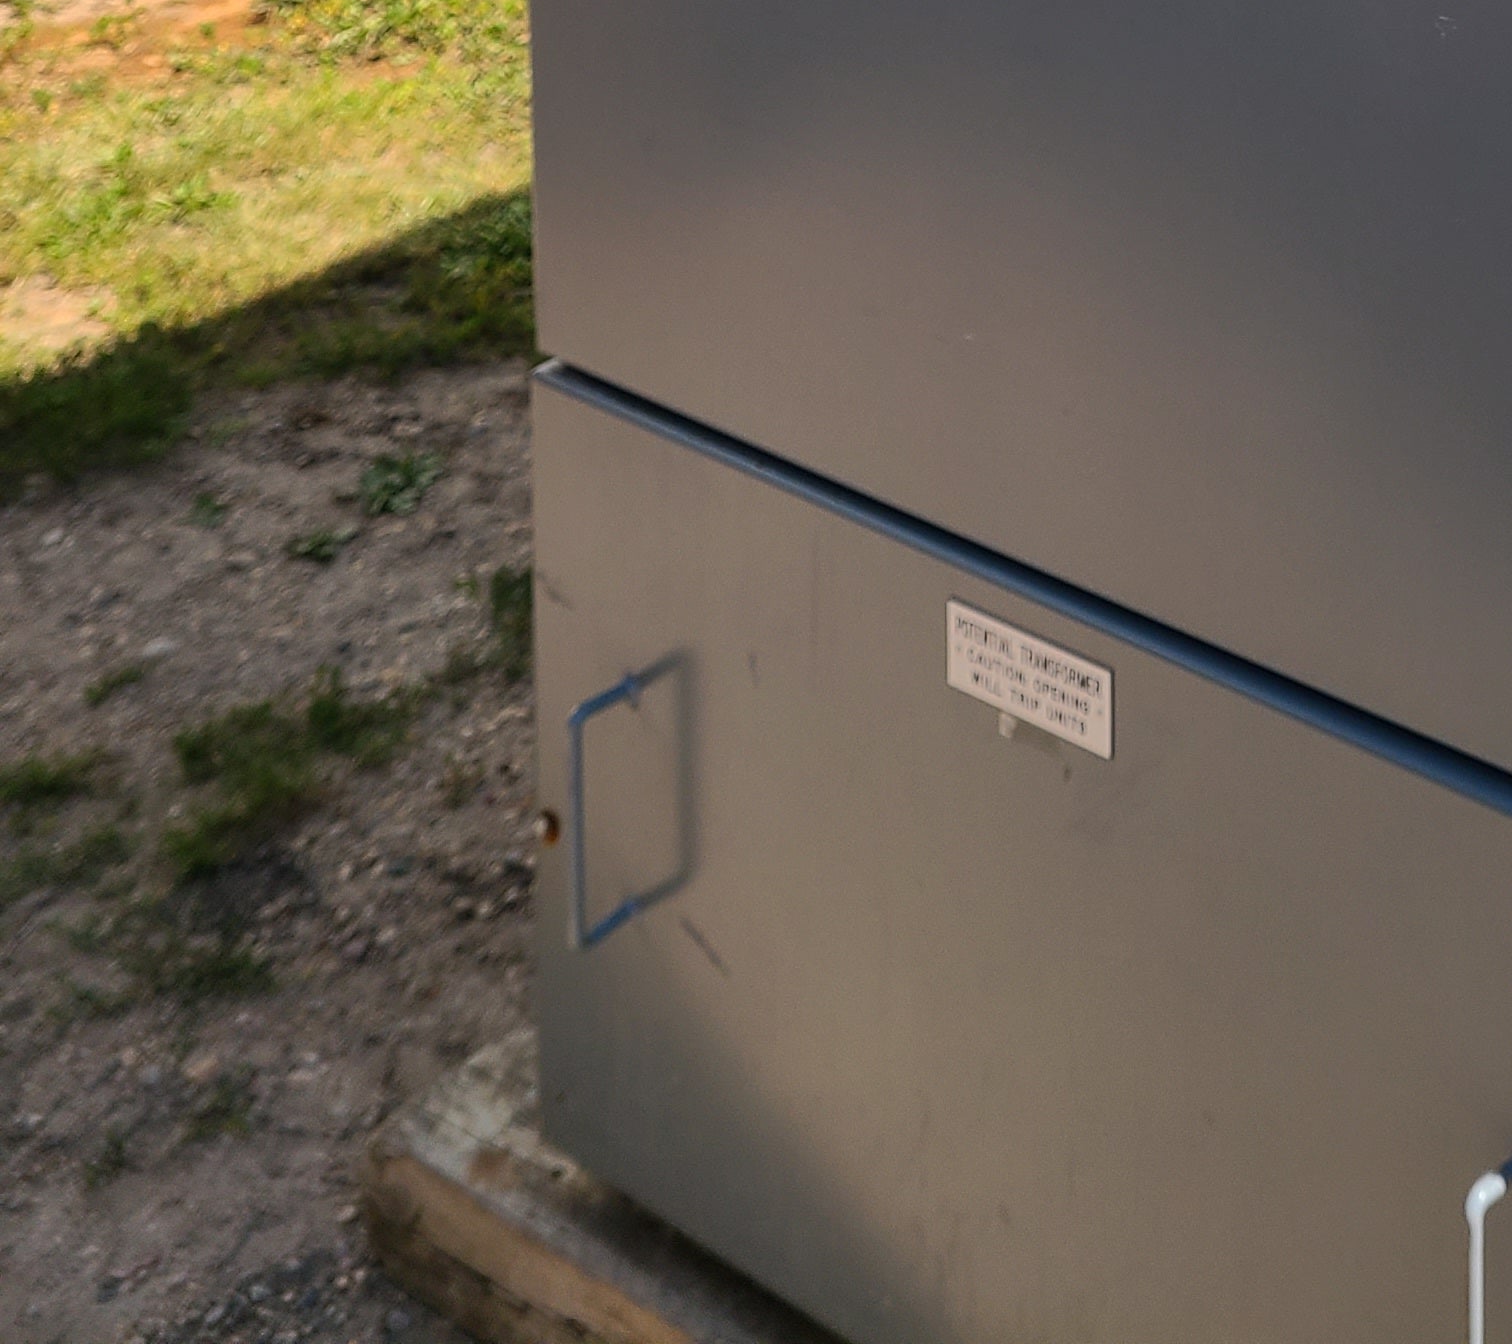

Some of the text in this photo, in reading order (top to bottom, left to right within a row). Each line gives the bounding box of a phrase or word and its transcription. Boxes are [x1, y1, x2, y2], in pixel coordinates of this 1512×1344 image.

[956, 616, 1101, 699] POTENTIAL TRANSFORMER
[971, 670, 1087, 737] WILL TRIP UNITS
[1033, 677, 1089, 715] OPENING
